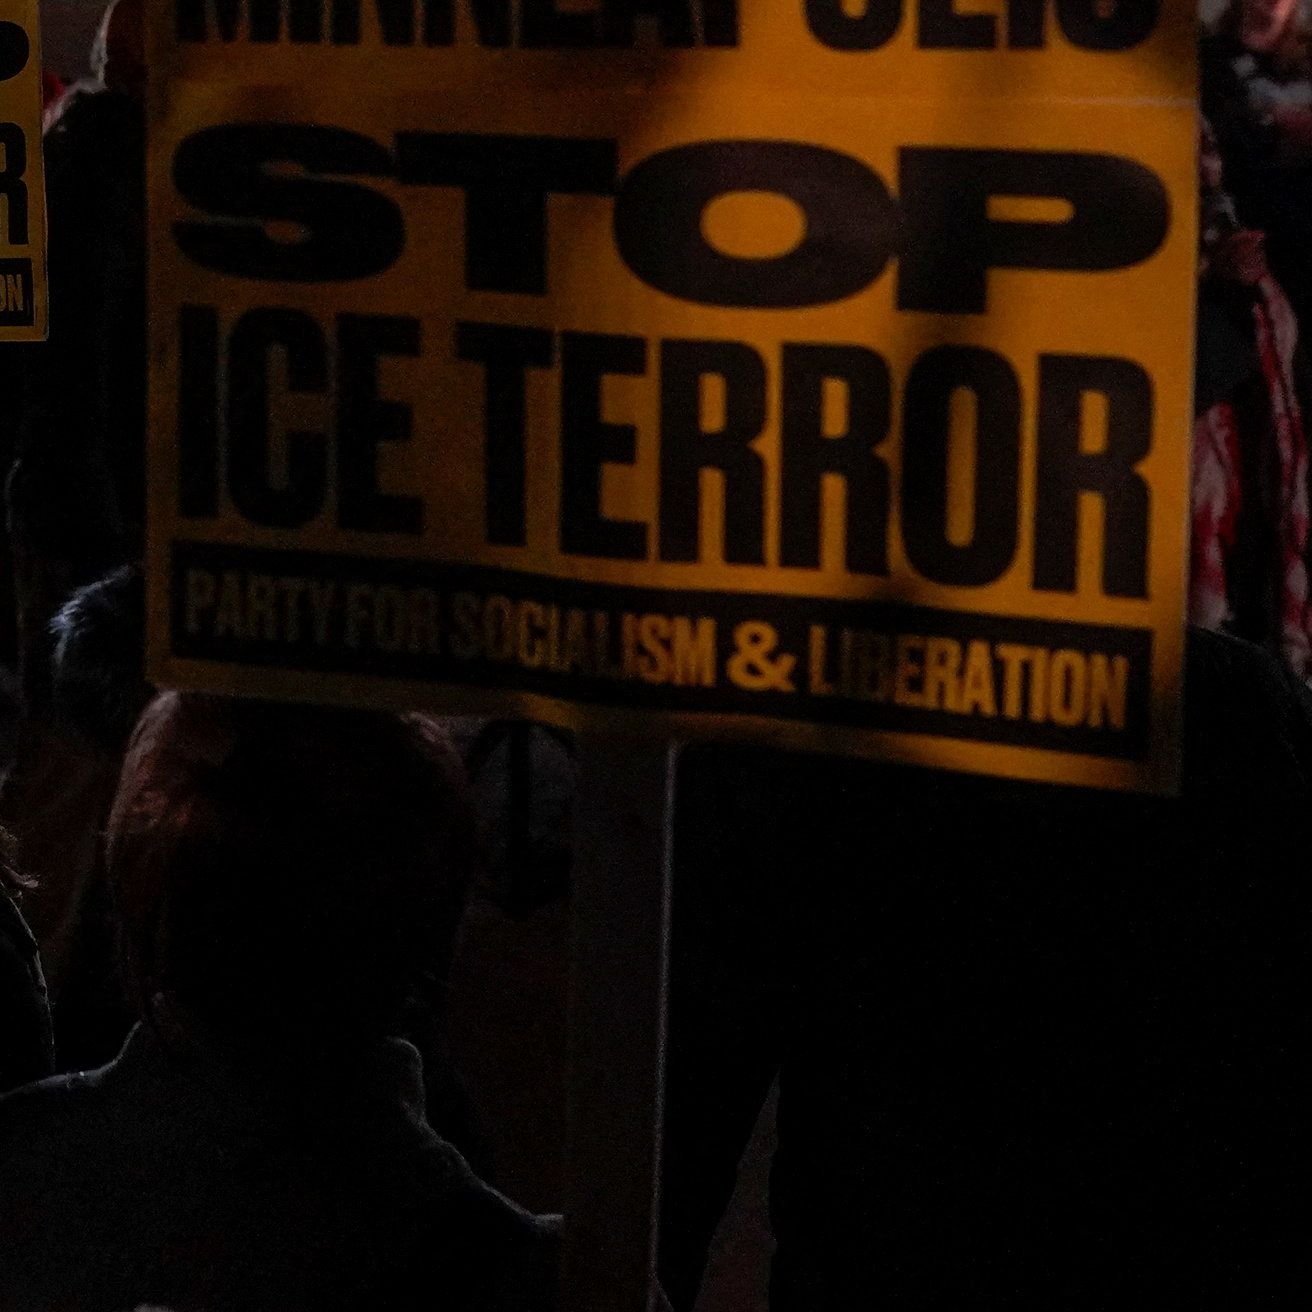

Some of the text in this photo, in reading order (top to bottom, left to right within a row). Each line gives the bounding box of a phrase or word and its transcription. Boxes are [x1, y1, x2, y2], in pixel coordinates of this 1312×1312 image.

[174, 122, 1171, 315] STOP
[179, 305, 1153, 601] ICE TERROR
[184, 566, 1130, 733] PARTY FOR SOCIALISM & LIBERATION
